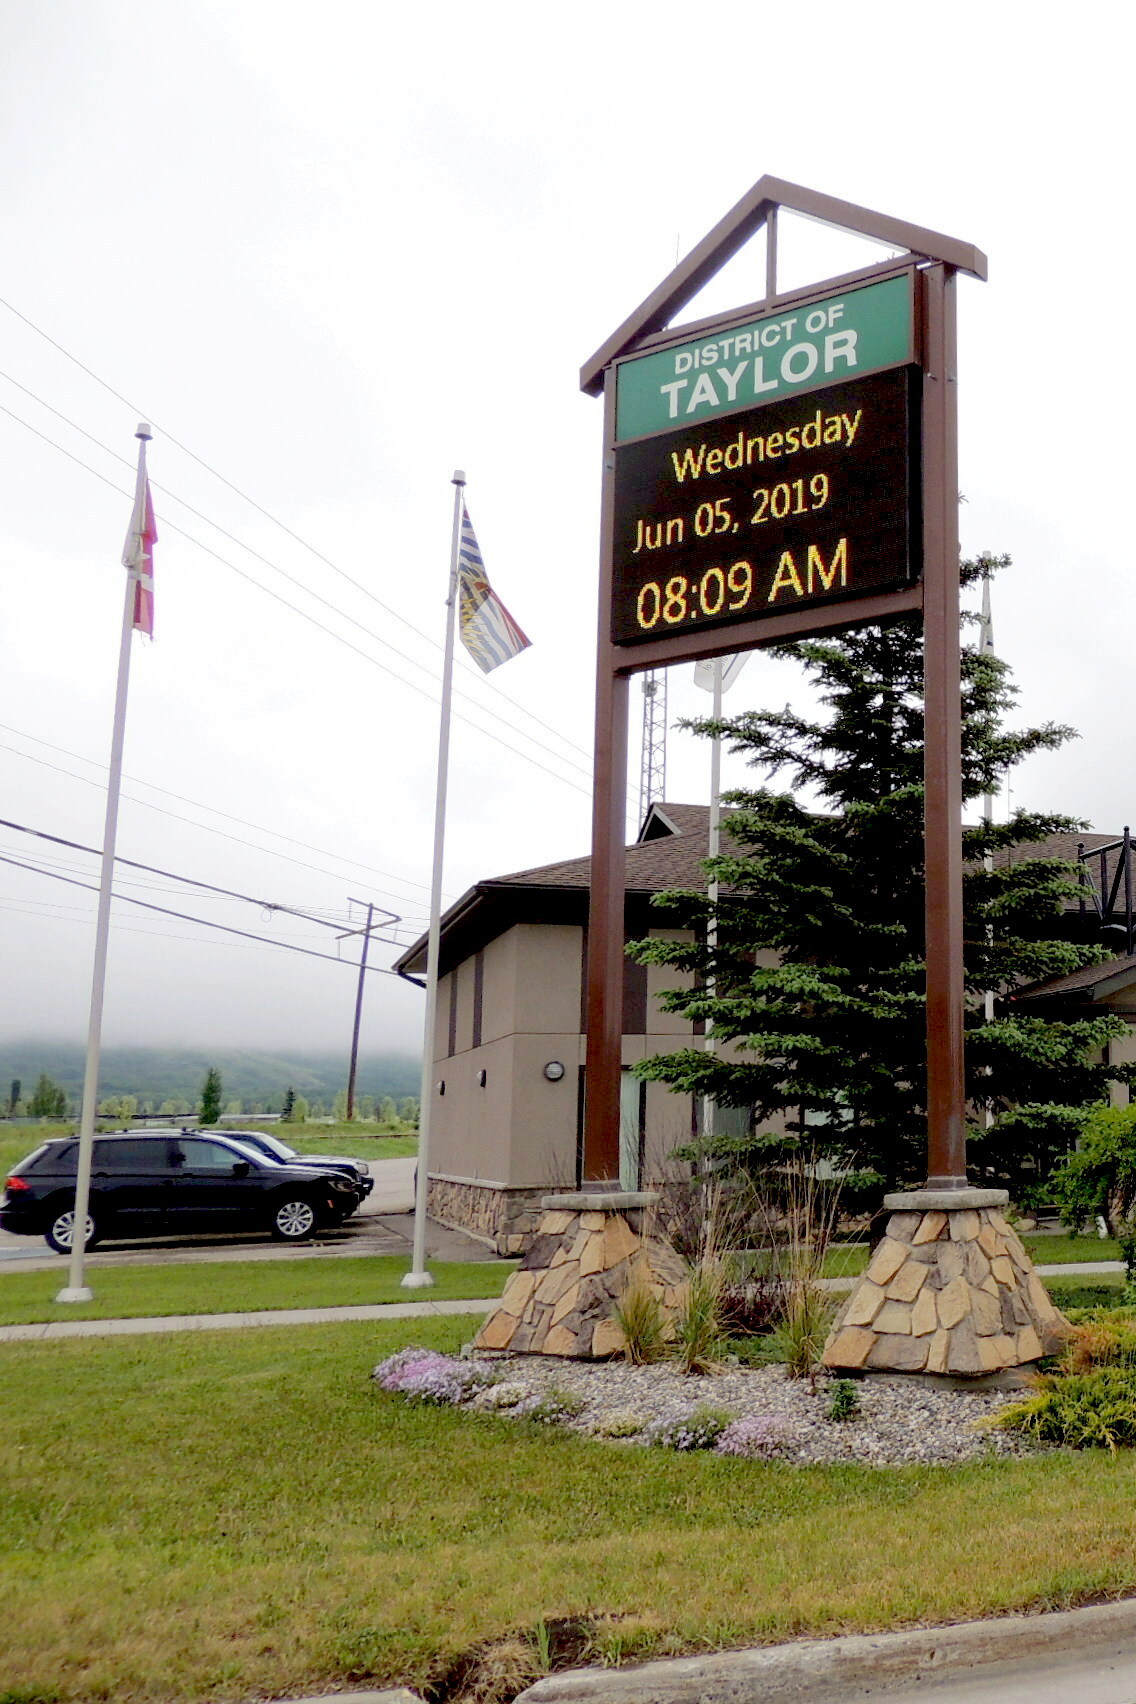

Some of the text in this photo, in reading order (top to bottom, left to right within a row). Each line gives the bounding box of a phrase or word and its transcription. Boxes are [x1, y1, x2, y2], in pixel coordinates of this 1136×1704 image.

[660, 329, 858, 419] TAYLOR
[675, 303, 844, 375] DISTRICT OF
[670, 408, 863, 484] Wednesday
[632, 473, 829, 554] Jun 05, 2019
[636, 537, 848, 630] 08:09 AM
